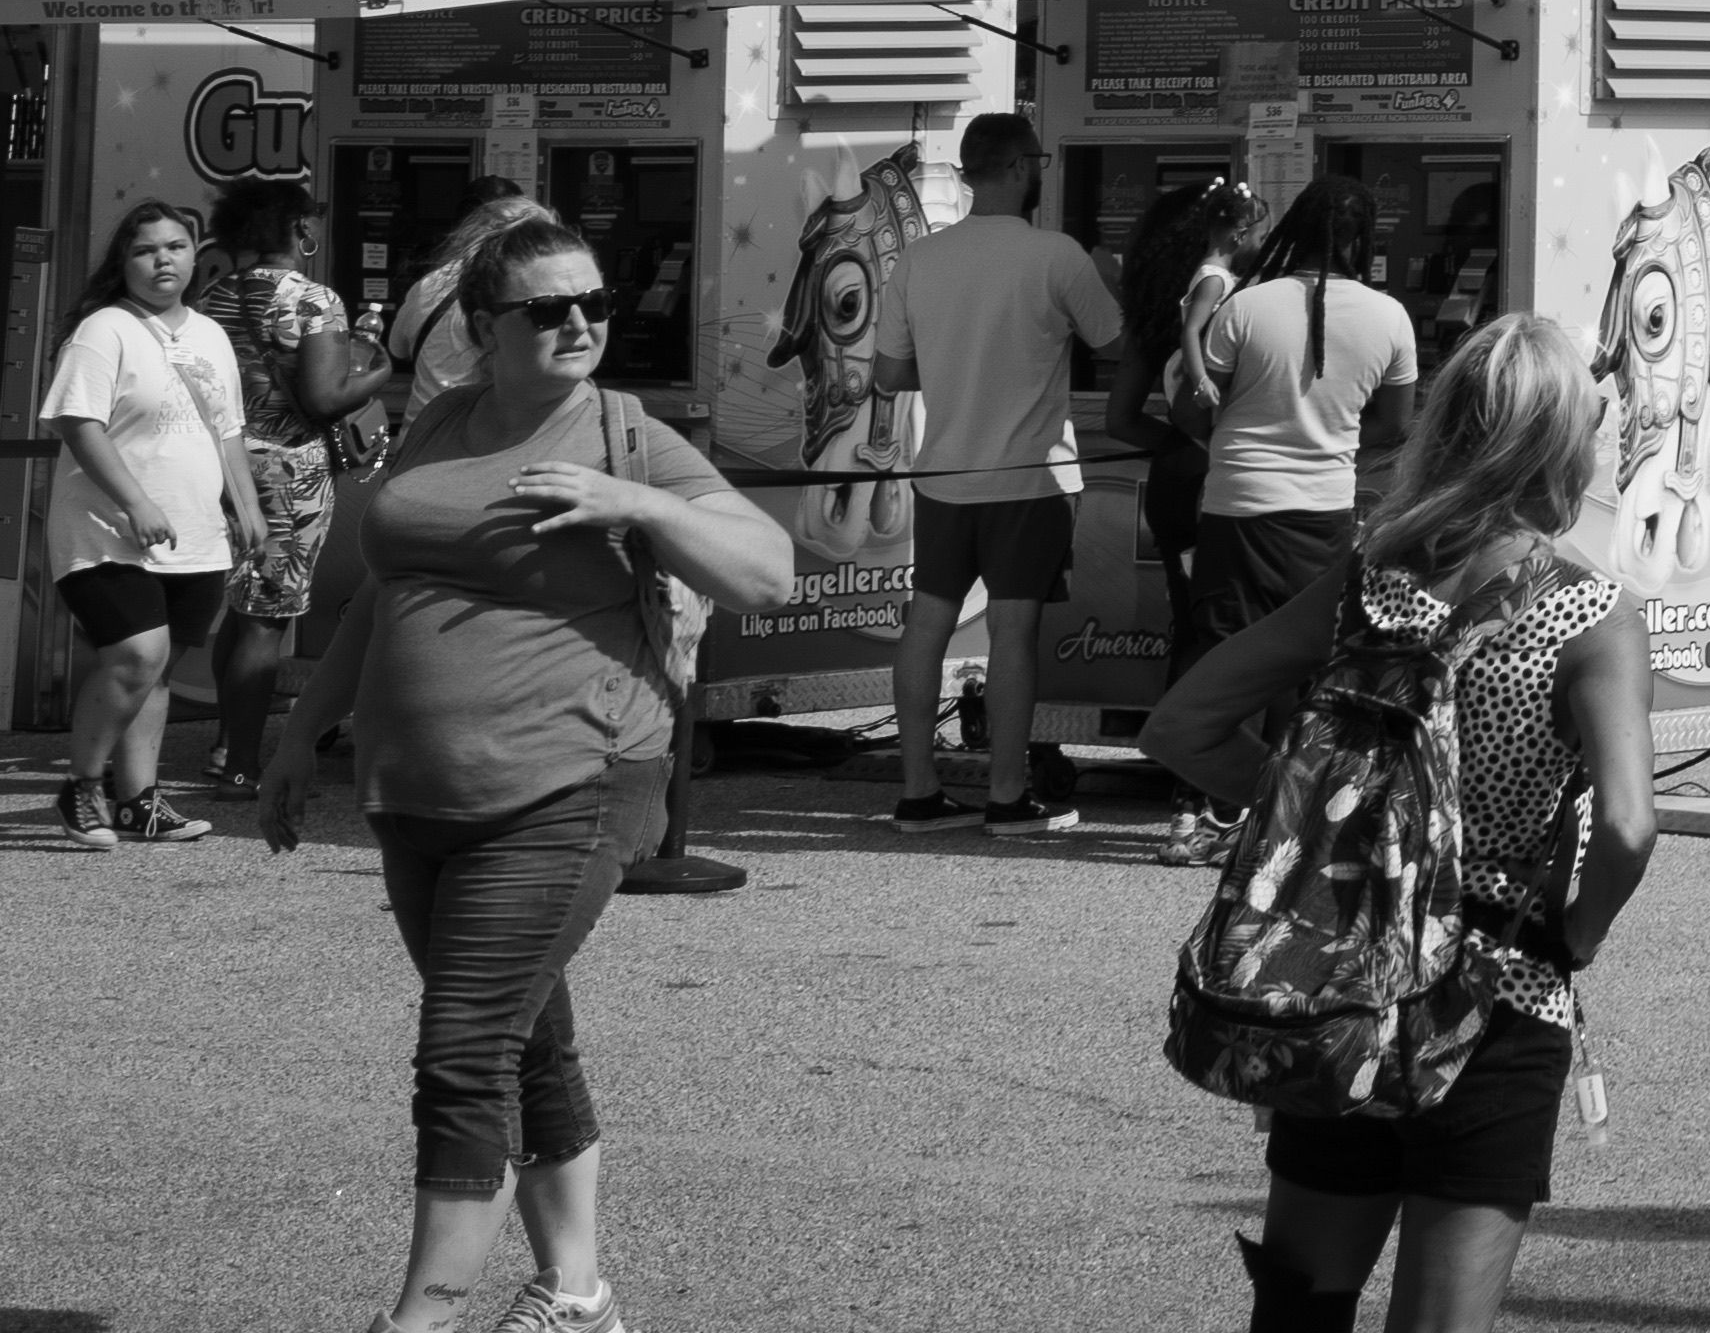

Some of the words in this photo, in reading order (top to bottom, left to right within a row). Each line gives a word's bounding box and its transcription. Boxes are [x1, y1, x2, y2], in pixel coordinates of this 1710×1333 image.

[42, 0, 145, 18] Welcome
[150, 1, 174, 17] to
[520, 8, 588, 25] CREDIT
[595, 7, 664, 24] PRICES
[1320, 14, 1360, 24] CREDITS
[1321, 27, 1361, 38] CREDITS
[1320, 42, 1360, 51] CREDITS
[1091, 77, 1125, 90] PLEASE
[1127, 77, 1151, 90] TAKE
[1154, 76, 1193, 89] RECEIPT
[1195, 76, 1215, 89] FOR
[1313, 74, 1375, 87] DESIGNATED
[1377, 73, 1438, 86] WRISTBAND
[1440, 72, 1468, 85] AREA
[358, 83, 387, 94] PLEASE
[388, 83, 408, 94] TAKE
[409, 83, 441, 94] RECEIPT
[443, 83, 460, 94] FOR
[540, 83, 591, 94] DESIGNATED
[593, 83, 643, 94] WRISTBAND
[645, 83, 667, 94] AREA
[1265, 106, 1283, 118] $36
[740, 614, 774, 638] Like
[778, 615, 795, 633] us
[799, 615, 819, 631] on
[823, 603, 898, 630] Facebook
